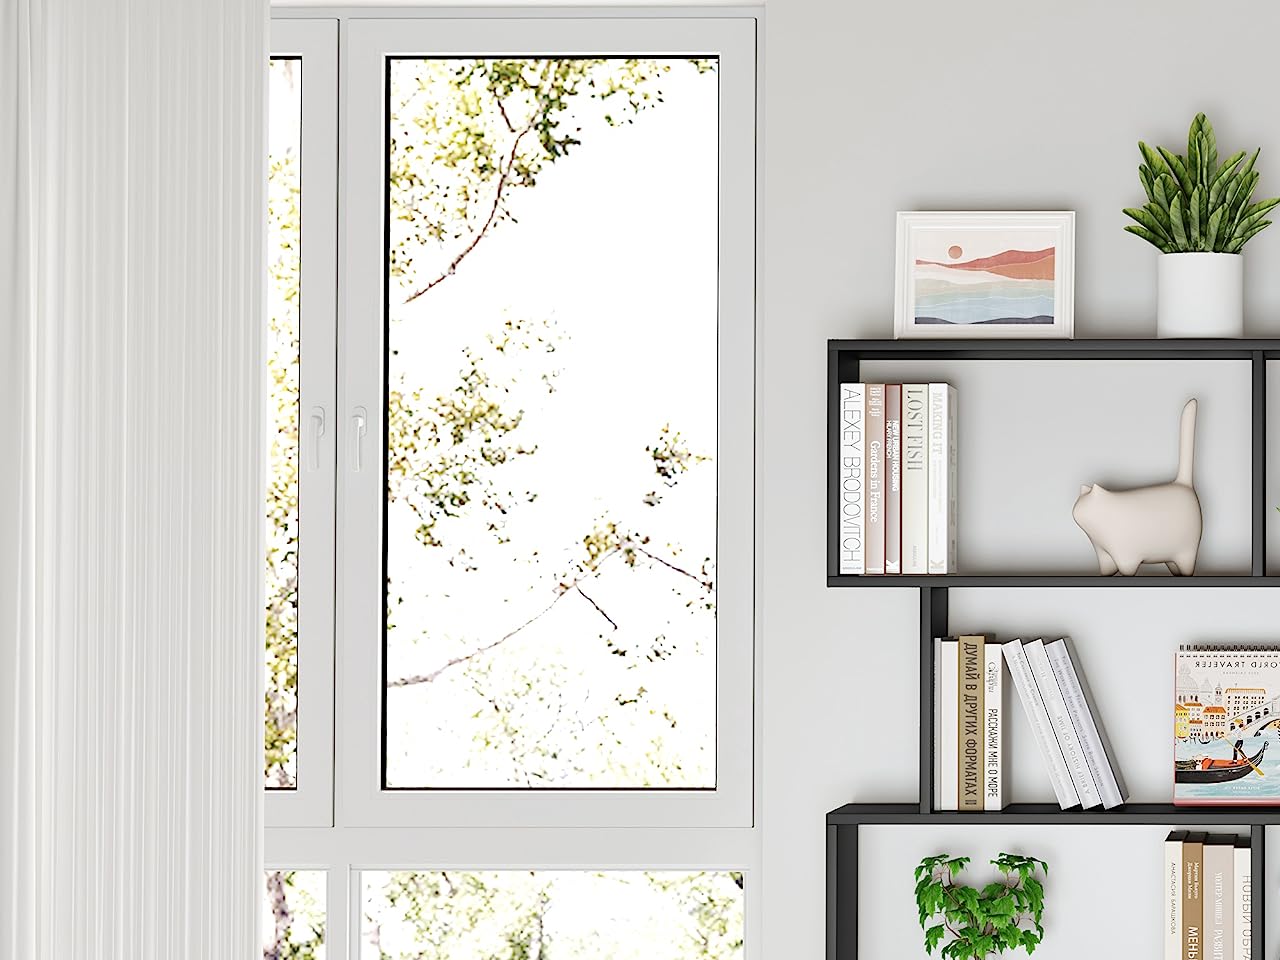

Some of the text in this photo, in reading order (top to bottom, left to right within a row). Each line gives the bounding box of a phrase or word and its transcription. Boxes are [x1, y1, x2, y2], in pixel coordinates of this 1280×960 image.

[844, 389, 861, 451] ALEXEY
[908, 389, 923, 471] LOST FISH
[932, 392, 943, 440] MAKING
[892, 420, 900, 491] NEW URBAN HOUSING
[932, 442, 943, 454] IT
[870, 441, 880, 522] Gardens in France
[843, 457, 861, 562] BRODOVITCH
[964, 642, 979, 680] ДУМАЙ
[964, 694, 977, 735] ДРУГИХ
[988, 708, 998, 749] РАССКАЖИ
[1056, 715, 1067, 731] TIME
[965, 739, 977, 795] ФОРМАТАХ
[988, 751, 998, 767] МНЕ
[1066, 742, 1082, 770] HISTORY
[988, 777, 998, 797] МОРЕ
